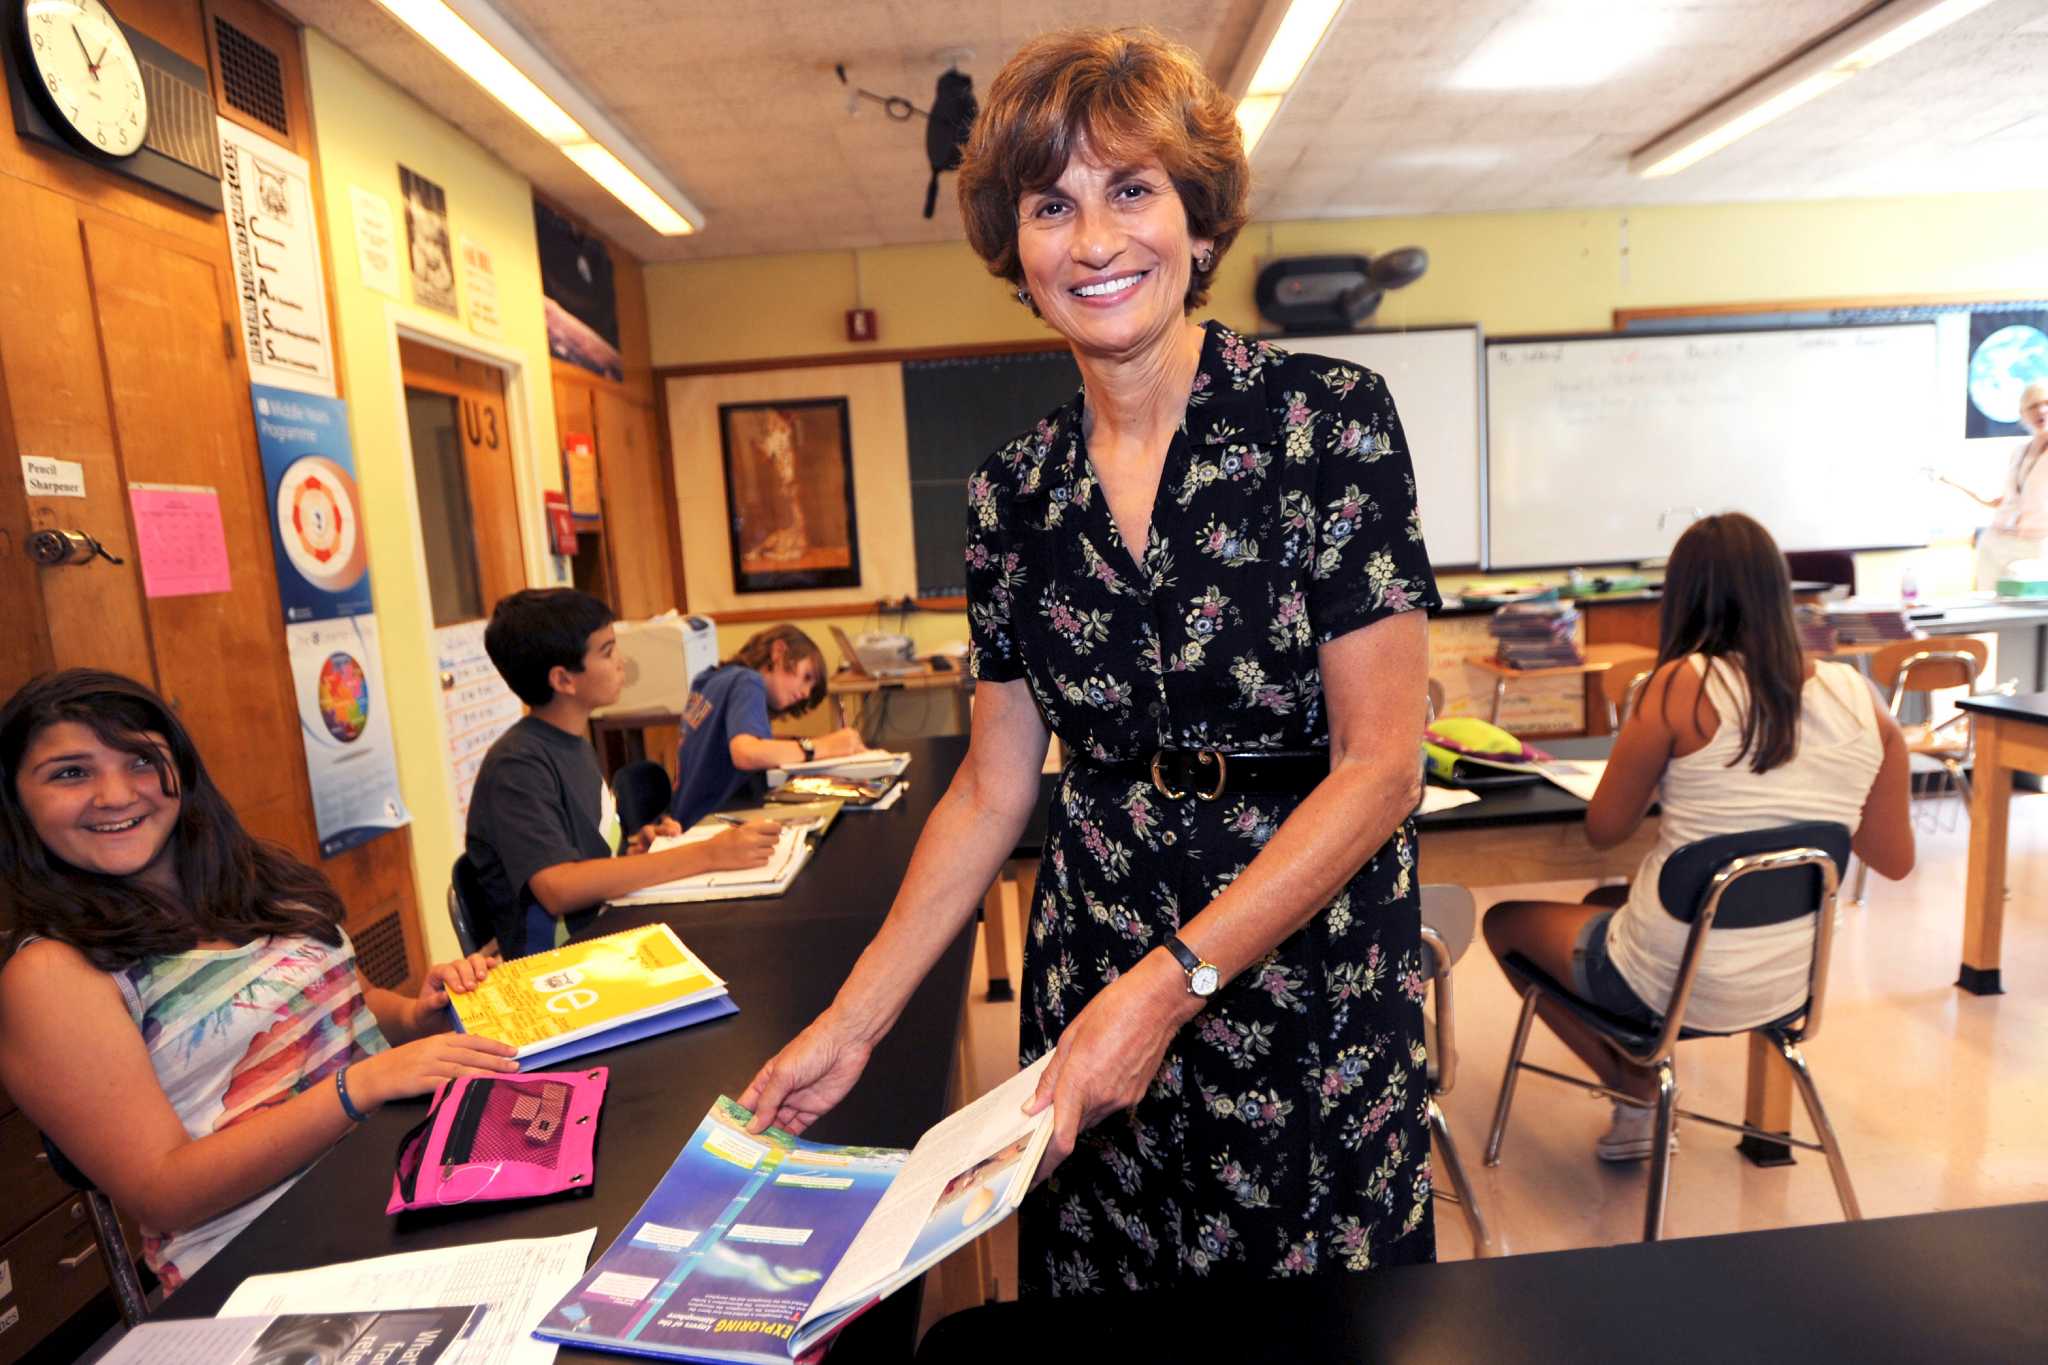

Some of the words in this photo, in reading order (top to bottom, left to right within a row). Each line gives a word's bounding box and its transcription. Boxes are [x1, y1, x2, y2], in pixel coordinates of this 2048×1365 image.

[27, 462, 57, 476] Pencil
[30, 479, 79, 493] Sharpener
[713, 1318, 795, 1340] EXPLORING
